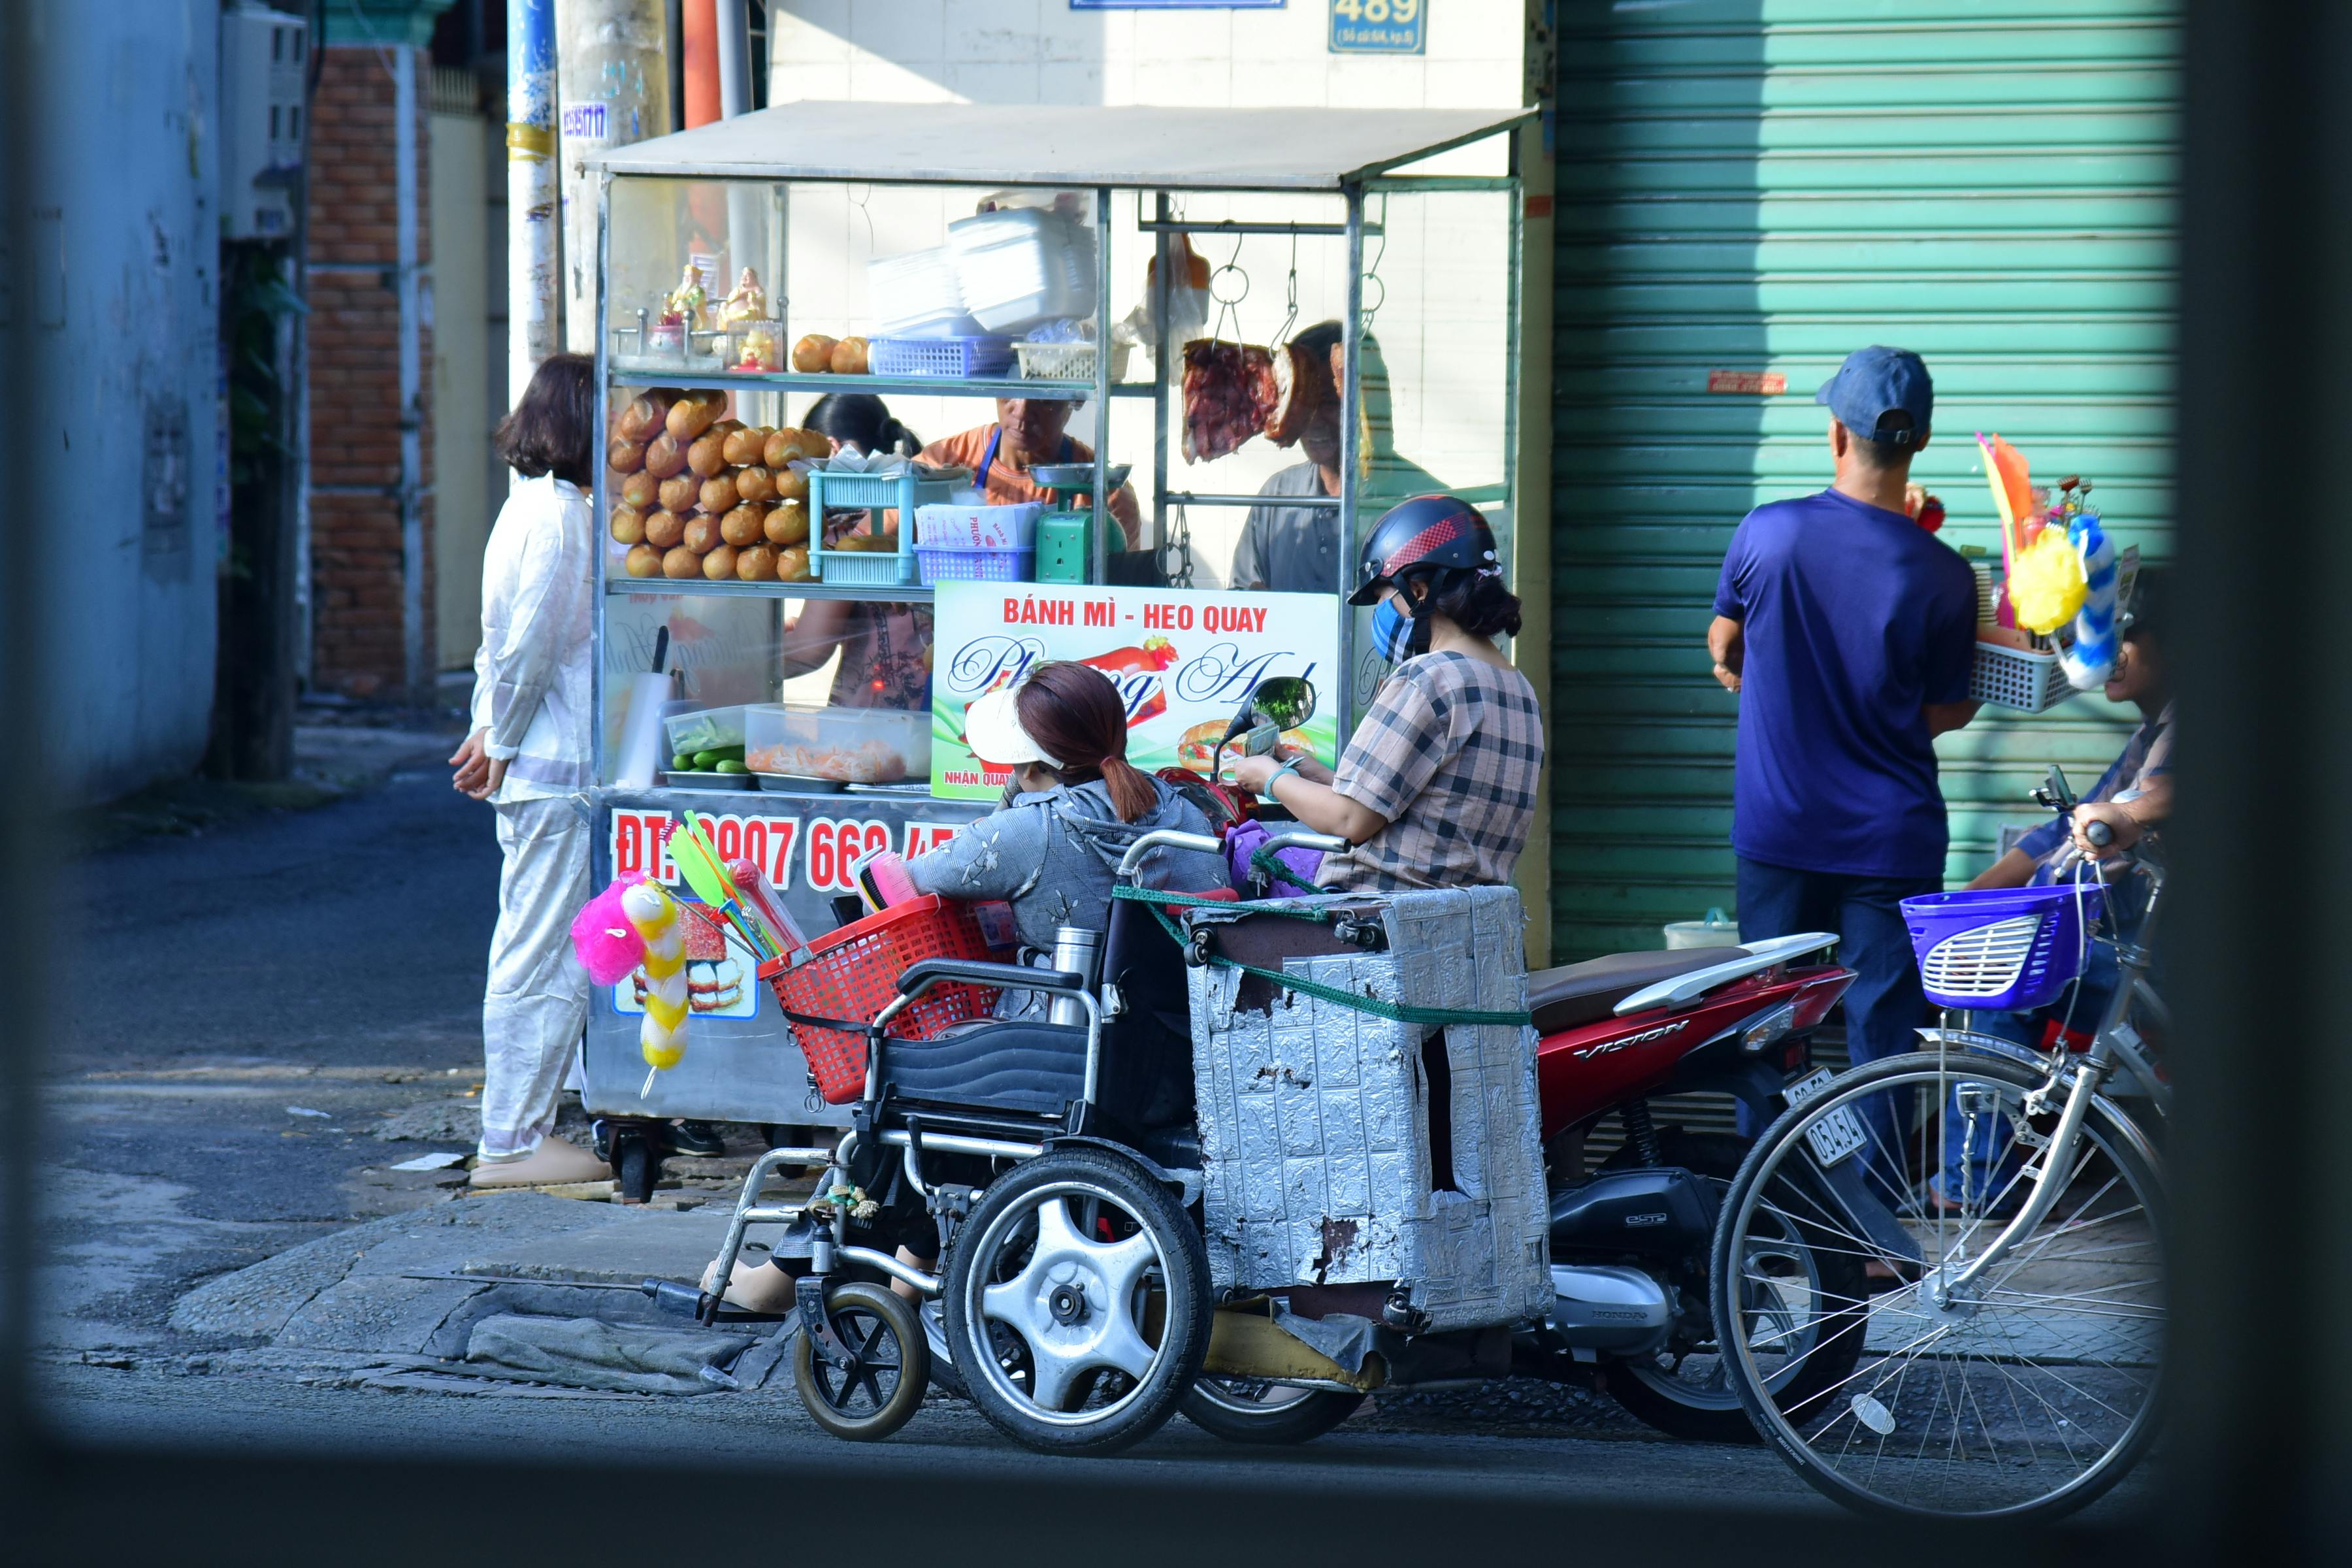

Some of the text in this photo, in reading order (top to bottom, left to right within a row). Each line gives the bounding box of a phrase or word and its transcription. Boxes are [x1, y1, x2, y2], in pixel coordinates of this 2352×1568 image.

[1335, 0, 1417, 23] 489
[1004, 594, 1073, 625] BÁNH
[1084, 596, 1115, 627] MÌ
[1143, 604, 1194, 630] HEO
[1203, 606, 1267, 634] QUAY
[945, 770, 979, 787] NHẬN
[1573, 1020, 1690, 1058] VISION
[1592, 1311, 1644, 1319] HONDA
